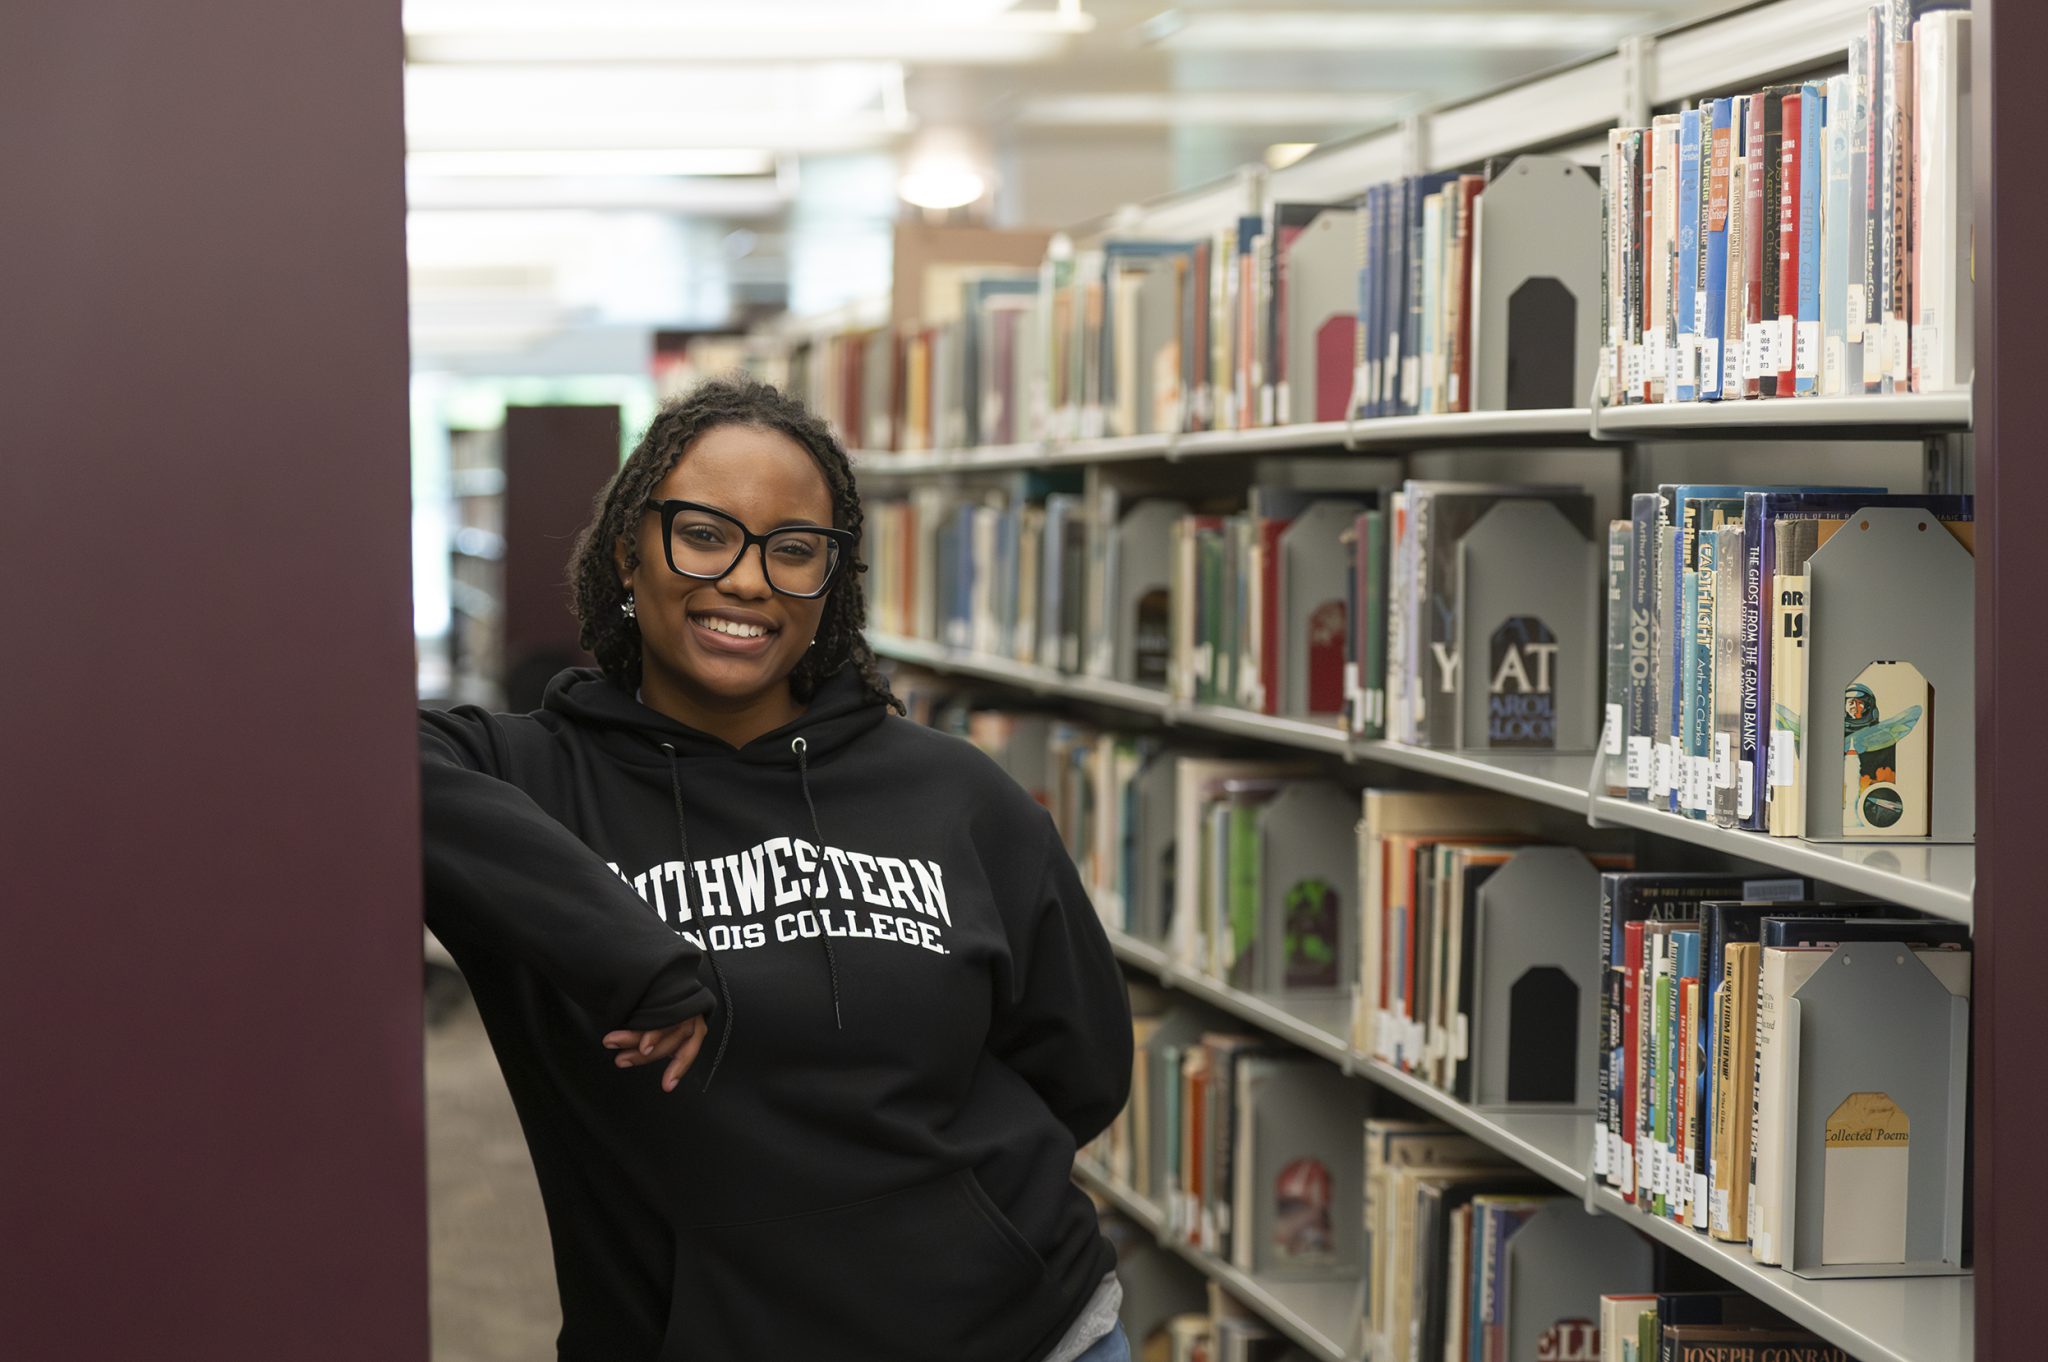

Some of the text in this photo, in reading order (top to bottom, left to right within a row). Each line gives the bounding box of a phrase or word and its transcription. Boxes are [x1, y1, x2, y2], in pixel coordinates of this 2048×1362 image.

[1703, 115, 1713, 155] Agatha
[1702, 158, 1711, 201] Christie
[1766, 167, 1775, 225] Agatha
[1801, 189, 1813, 308] THIRD GIRL
[1867, 218, 1875, 245] First
[1866, 245, 1875, 271] Lady
[1867, 285, 1875, 318] Crime
[1639, 521, 1648, 556] Arthur
[1631, 607, 1650, 687] 2010:
[1743, 546, 1759, 750] THE GHOST FROM THE GRAND BANKS
[1696, 657, 1706, 692] Arthur
[1633, 687, 1643, 731] odyssey
[1695, 708, 1706, 747] Clarke
[606, 837, 951, 928] UTHWESTERN
[1602, 893, 1611, 956] ARTHUR
[1649, 902, 1702, 920] ARTH
[676, 923, 767, 951] NOIS
[1669, 988, 1678, 1022] CLARKE
[1723, 1005, 1731, 1033] FROM
[1682, 1347, 1847, 1362] JOSEPH CONRAD
